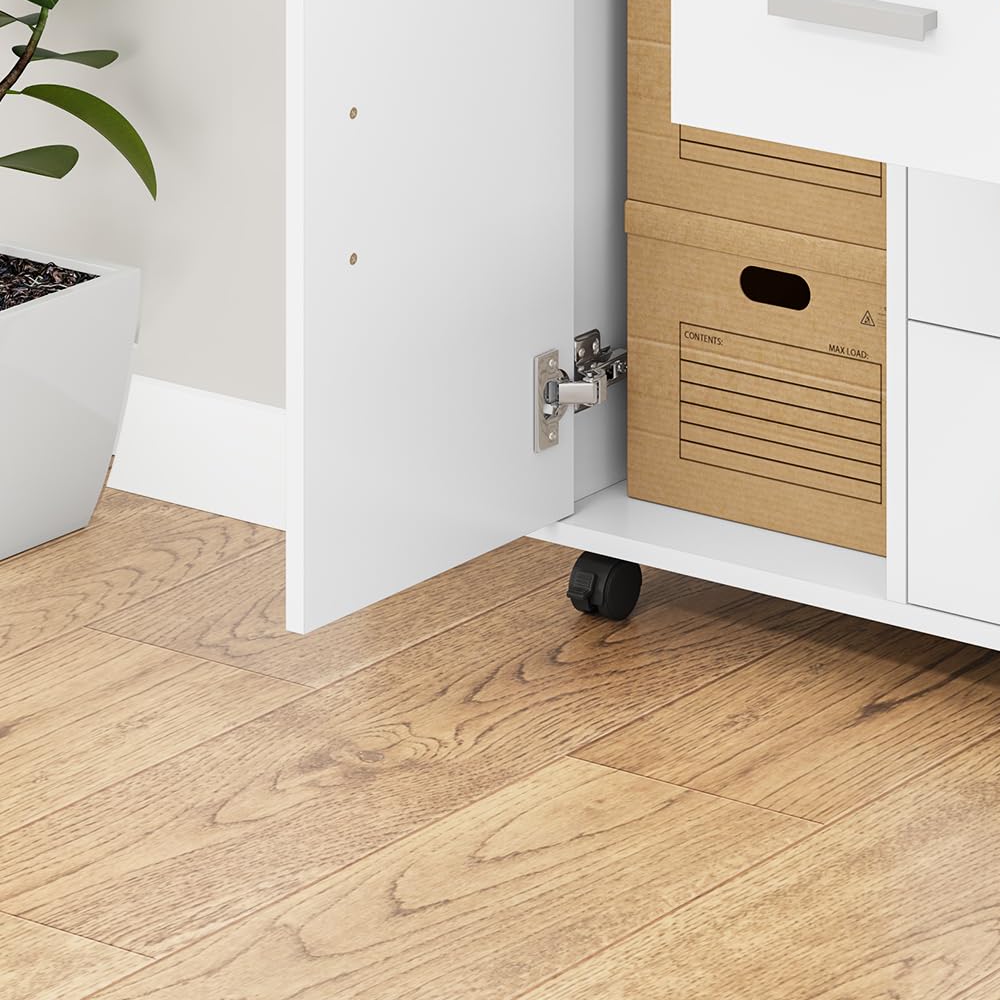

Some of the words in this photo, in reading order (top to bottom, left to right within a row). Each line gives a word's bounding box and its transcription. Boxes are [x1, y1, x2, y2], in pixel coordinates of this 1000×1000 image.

[684, 330, 724, 346] CONTENTS:
[828, 343, 845, 355] MAX
[847, 346, 869, 359] LOAD:
